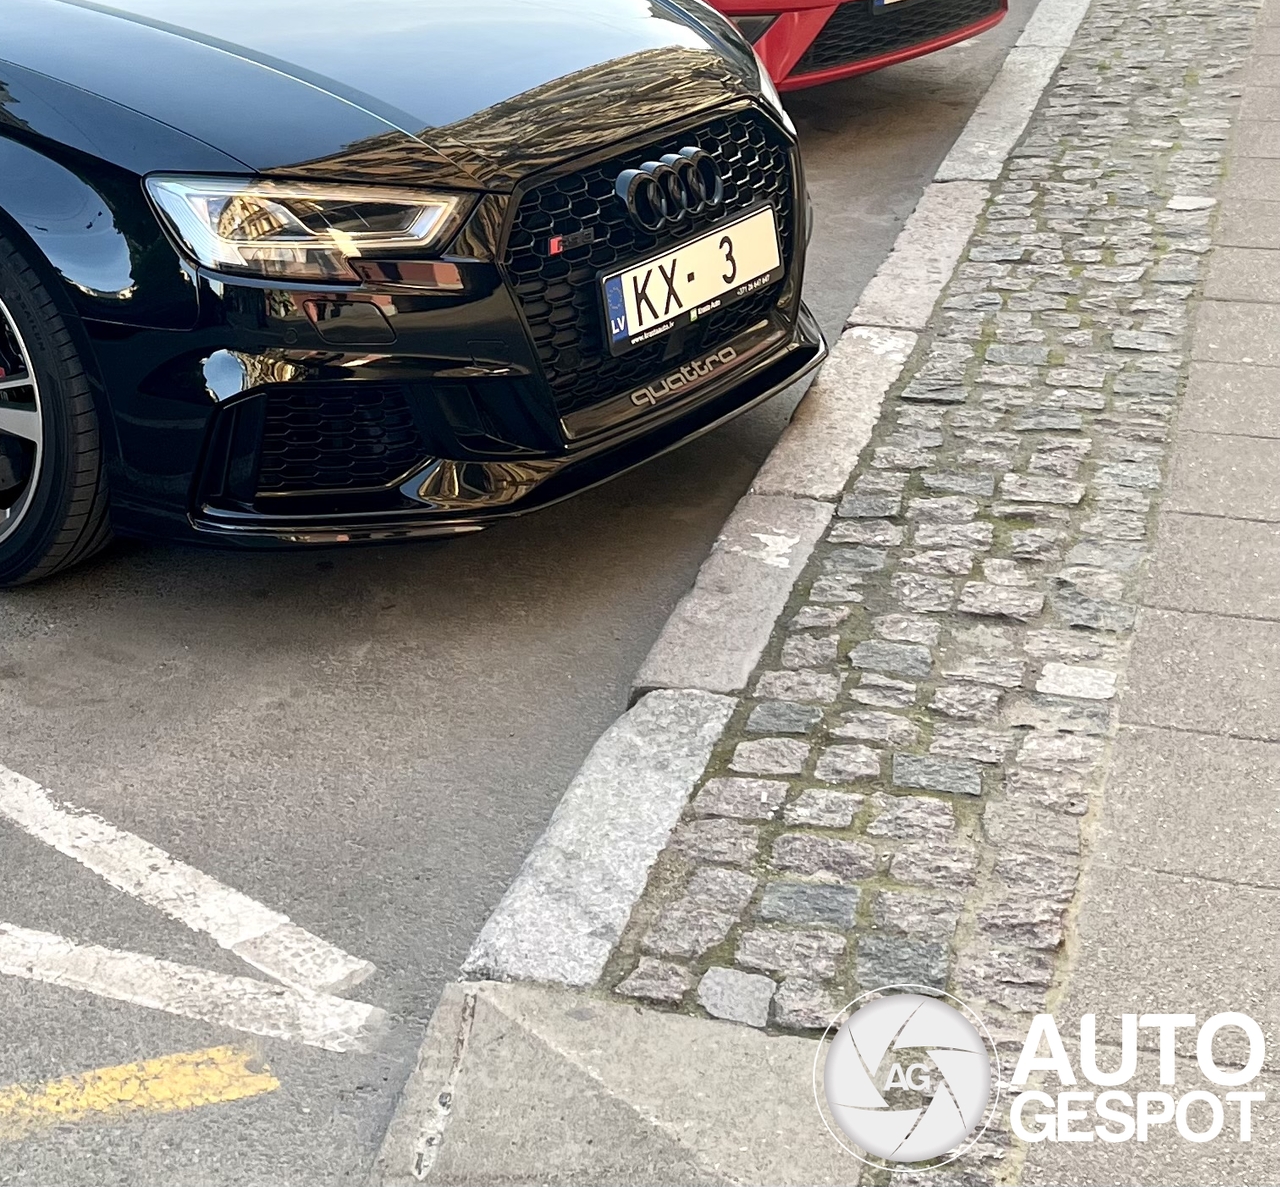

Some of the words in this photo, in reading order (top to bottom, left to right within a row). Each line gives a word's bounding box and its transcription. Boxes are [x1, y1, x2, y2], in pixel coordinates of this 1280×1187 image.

[718, 235, 737, 285] 3
[611, 315, 625, 335] LV
[631, 346, 737, 405] quattro
